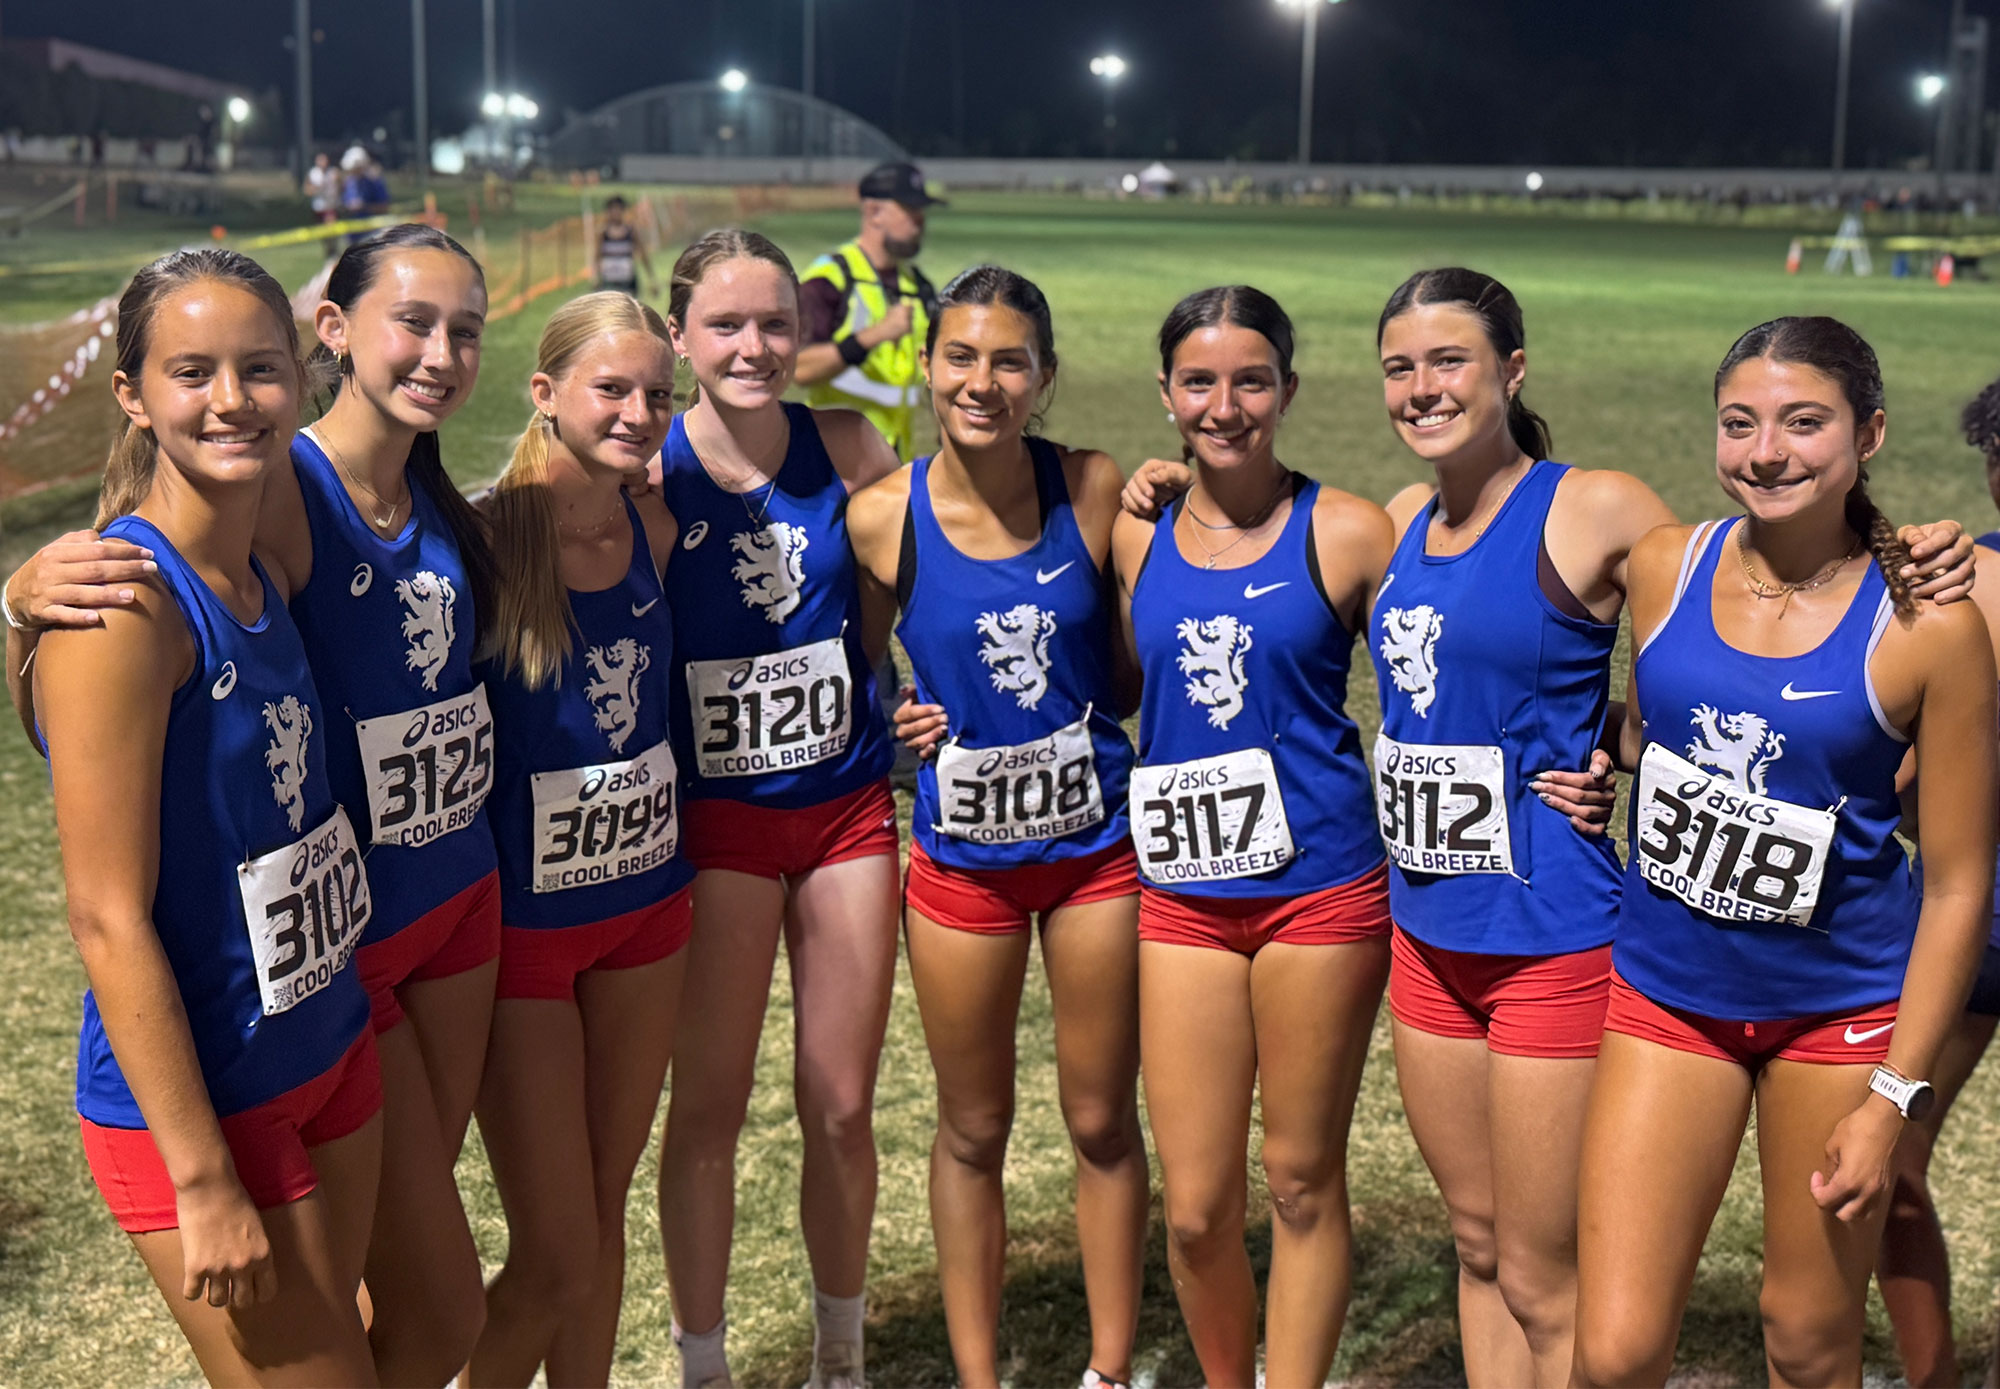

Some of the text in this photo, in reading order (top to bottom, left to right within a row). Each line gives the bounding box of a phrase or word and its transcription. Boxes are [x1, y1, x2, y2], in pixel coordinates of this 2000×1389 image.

[702, 675, 845, 754] 3120
[379, 721, 492, 829] 3125
[724, 733, 847, 773] COOL BREEZE
[400, 790, 489, 846] COOL BREE
[541, 781, 672, 865] 3099
[949, 755, 1090, 825] 3108
[969, 807, 1098, 842] COOL BREEZE
[1143, 782, 1266, 863] 3117
[1380, 770, 1492, 852] 3112
[561, 838, 675, 886] COOL BREEZE
[1164, 848, 1288, 880] COOL BREEZE
[1422, 851, 1502, 871] BREEZE
[1639, 787, 1814, 911] 3118
[265, 848, 367, 983] 3102
[1648, 862, 1803, 925] COOL BREEZE
